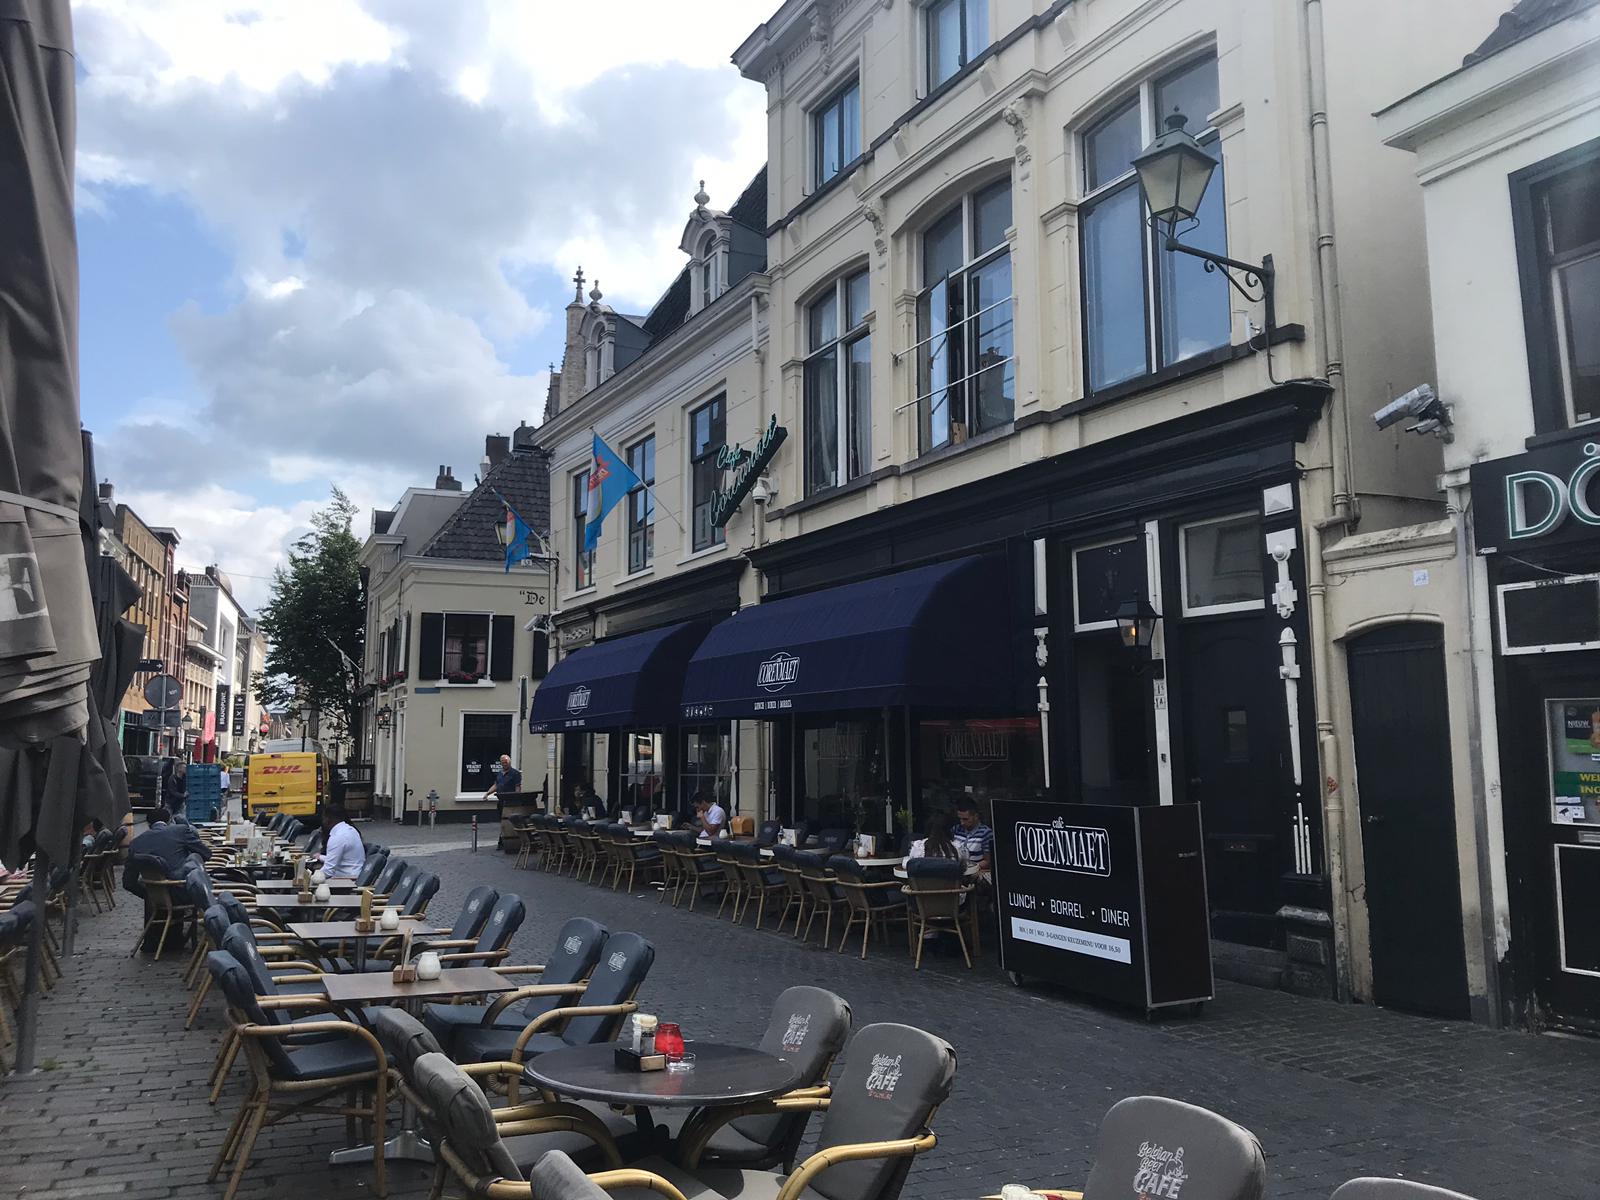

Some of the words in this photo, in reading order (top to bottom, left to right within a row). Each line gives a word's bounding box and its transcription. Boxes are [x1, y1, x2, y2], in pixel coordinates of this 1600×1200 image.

[758, 660, 798, 683] CORENMAET
[263, 765, 302, 775] DHL
[1018, 826, 1107, 871] CORENMAET
[1008, 891, 1036, 910] LUNCH
[1050, 899, 1085, 919] BORREL
[1101, 907, 1130, 927] DINER
[1137, 1141, 1174, 1161] Belgian
[1139, 1157, 1164, 1172] Beer
